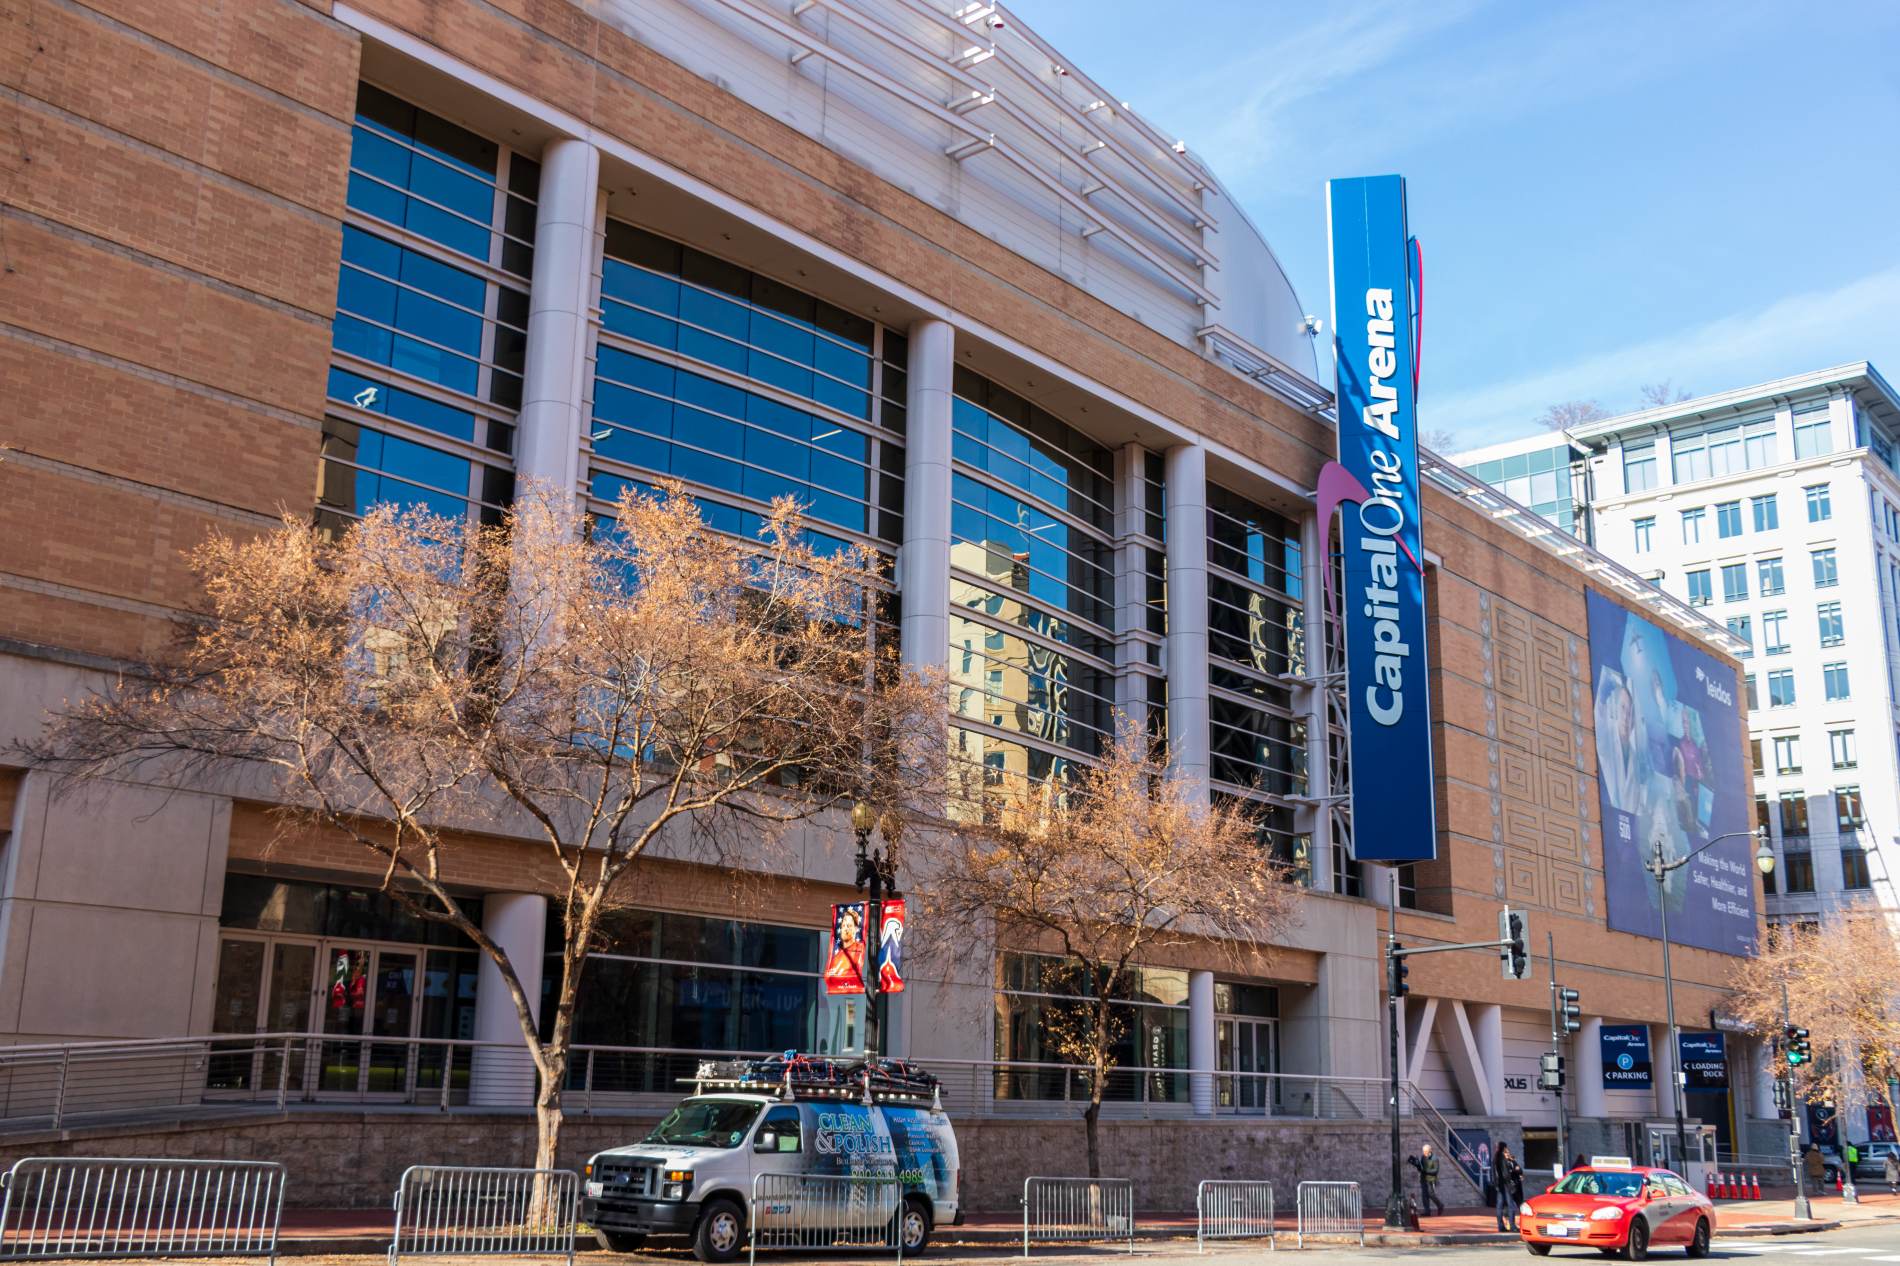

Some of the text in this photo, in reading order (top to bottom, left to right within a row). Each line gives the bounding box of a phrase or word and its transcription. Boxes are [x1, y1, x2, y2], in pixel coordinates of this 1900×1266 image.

[1363, 287, 1399, 440] Arena
[1706, 676, 1732, 706] leidos
[1698, 851, 1746, 877] Making the World
[1737, 885, 1748, 897] and
[1712, 897, 1750, 918] More Efficient
[1504, 1078, 1527, 1090] XUS
[1612, 1072, 1648, 1080] PARKING
[818, 1112, 873, 1132] CLEAN
